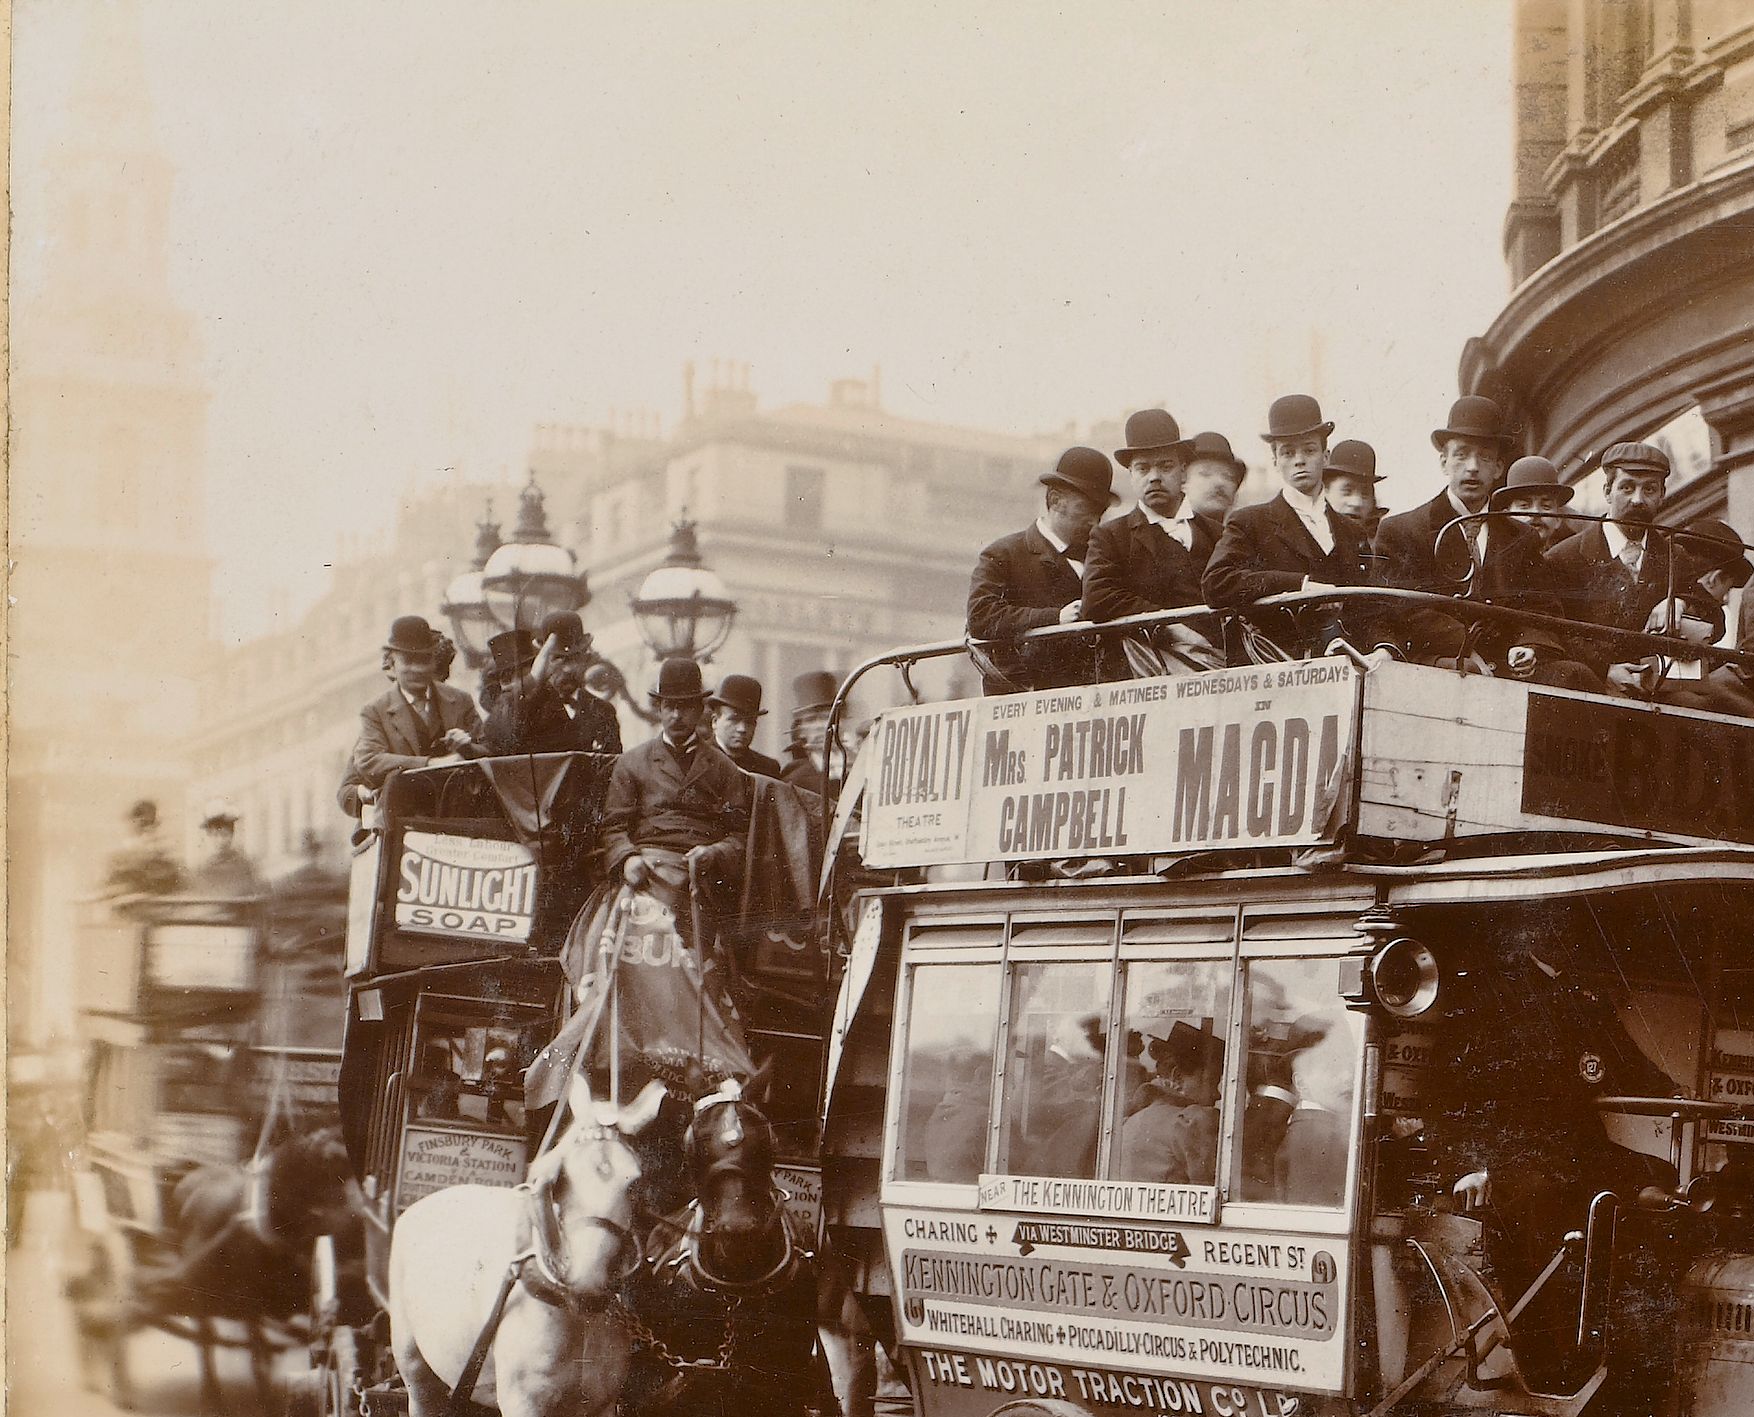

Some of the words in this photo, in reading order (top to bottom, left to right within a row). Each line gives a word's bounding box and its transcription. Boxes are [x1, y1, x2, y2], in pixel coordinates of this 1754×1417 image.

[993, 702, 1027, 720] EVERY
[1036, 696, 1082, 715] EVENING
[1094, 692, 1102, 708] &
[1109, 685, 1167, 706] MATINEES
[1177, 674, 1258, 698] WEDNESDAYS
[1264, 673, 1273, 689] &
[1278, 665, 1349, 688] SATURDAYS
[1255, 700, 1272, 711] IN
[878, 710, 971, 807] ROYALTY
[1043, 713, 1147, 782] PATRICK
[1172, 715, 1340, 843] MAGDA
[896, 813, 942, 829] THEATRE
[999, 787, 1127, 853] CAMPBELL
[397, 852, 538, 915] SUNLIGHT
[410, 910, 516, 932] SOAP
[407, 1151, 459, 1167] VICTORIA
[462, 1158, 516, 1173] STATION
[418, 1136, 479, 1153] FINSBURY
[481, 1140, 514, 1161] PARK
[404, 1170, 468, 1185] CAMDEN
[980, 1181, 1006, 1203] NEAR
[1013, 1180, 1038, 1206] THE
[1043, 1181, 1133, 1212] KENNINGTON
[904, 1219, 978, 1244] CHARING
[1019, 1225, 1037, 1242] VIA
[1039, 1225, 1120, 1248] WESTMINSTER
[1124, 1231, 1178, 1250] BRIDGE
[1203, 1240, 1281, 1268] REGENT
[904, 1254, 1035, 1302] KENNINGTON
[1040, 1264, 1096, 1308] GATE
[1102, 1275, 1118, 1310] &
[1000, 1316, 1054, 1345] CHARING
[1188, 1341, 1198, 1360] &
[921, 1351, 972, 1385] THE
[976, 1357, 1066, 1398] MOTOR
[1072, 1369, 1203, 1414] TRACTION
